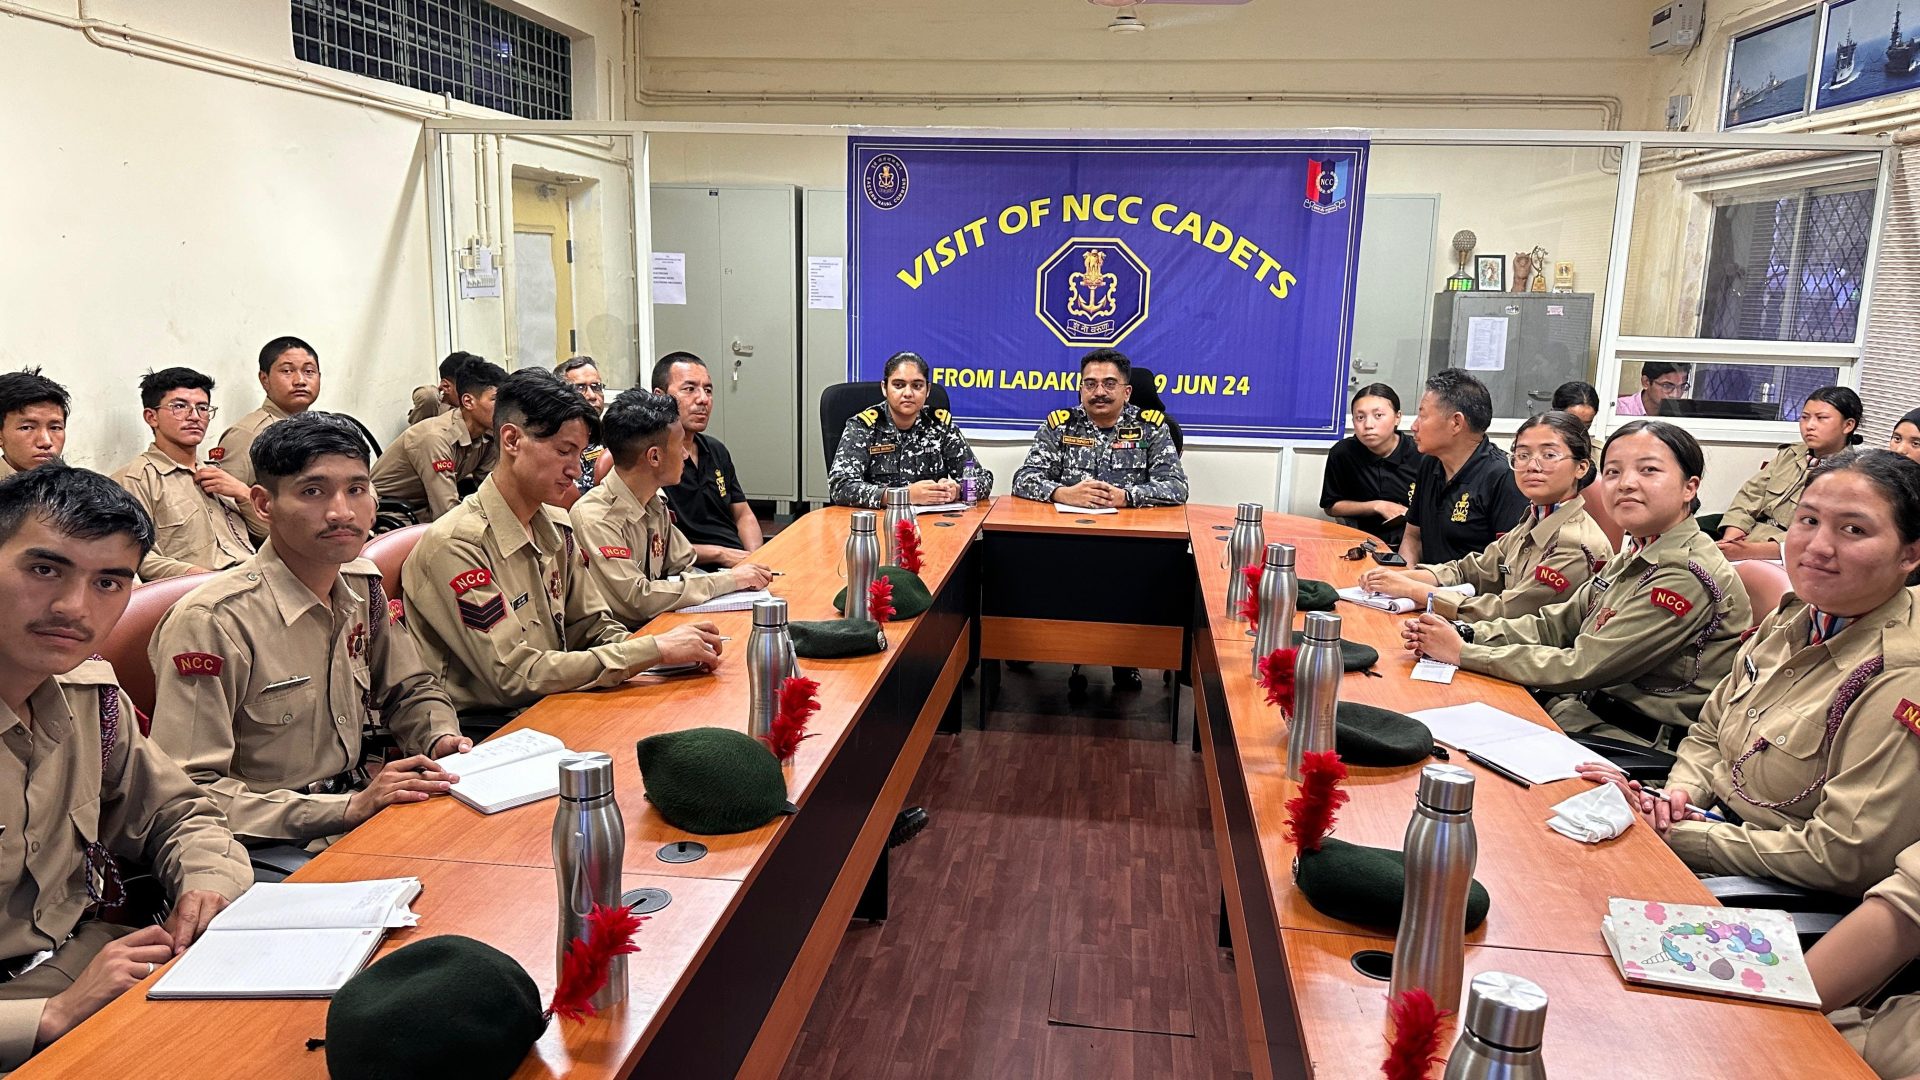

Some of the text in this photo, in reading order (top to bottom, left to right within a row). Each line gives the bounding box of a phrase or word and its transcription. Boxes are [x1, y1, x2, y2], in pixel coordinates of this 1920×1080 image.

[1320, 178, 1334, 186] NCC
[896, 216, 988, 290] VISIT
[998, 197, 1051, 235] OF
[1062, 193, 1143, 225] NCC
[1151, 203, 1298, 299] CADETS
[932, 367, 994, 389] FROM
[1171, 374, 1218, 395] JUN
[1222, 375, 1251, 396] 24
[436, 461, 453, 470] NCC
[606, 548, 627, 556] NCC
[456, 571, 486, 590] NCC
[1540, 569, 1565, 587] NCC
[1656, 592, 1685, 611] NCC
[180, 657, 214, 671] NCC
